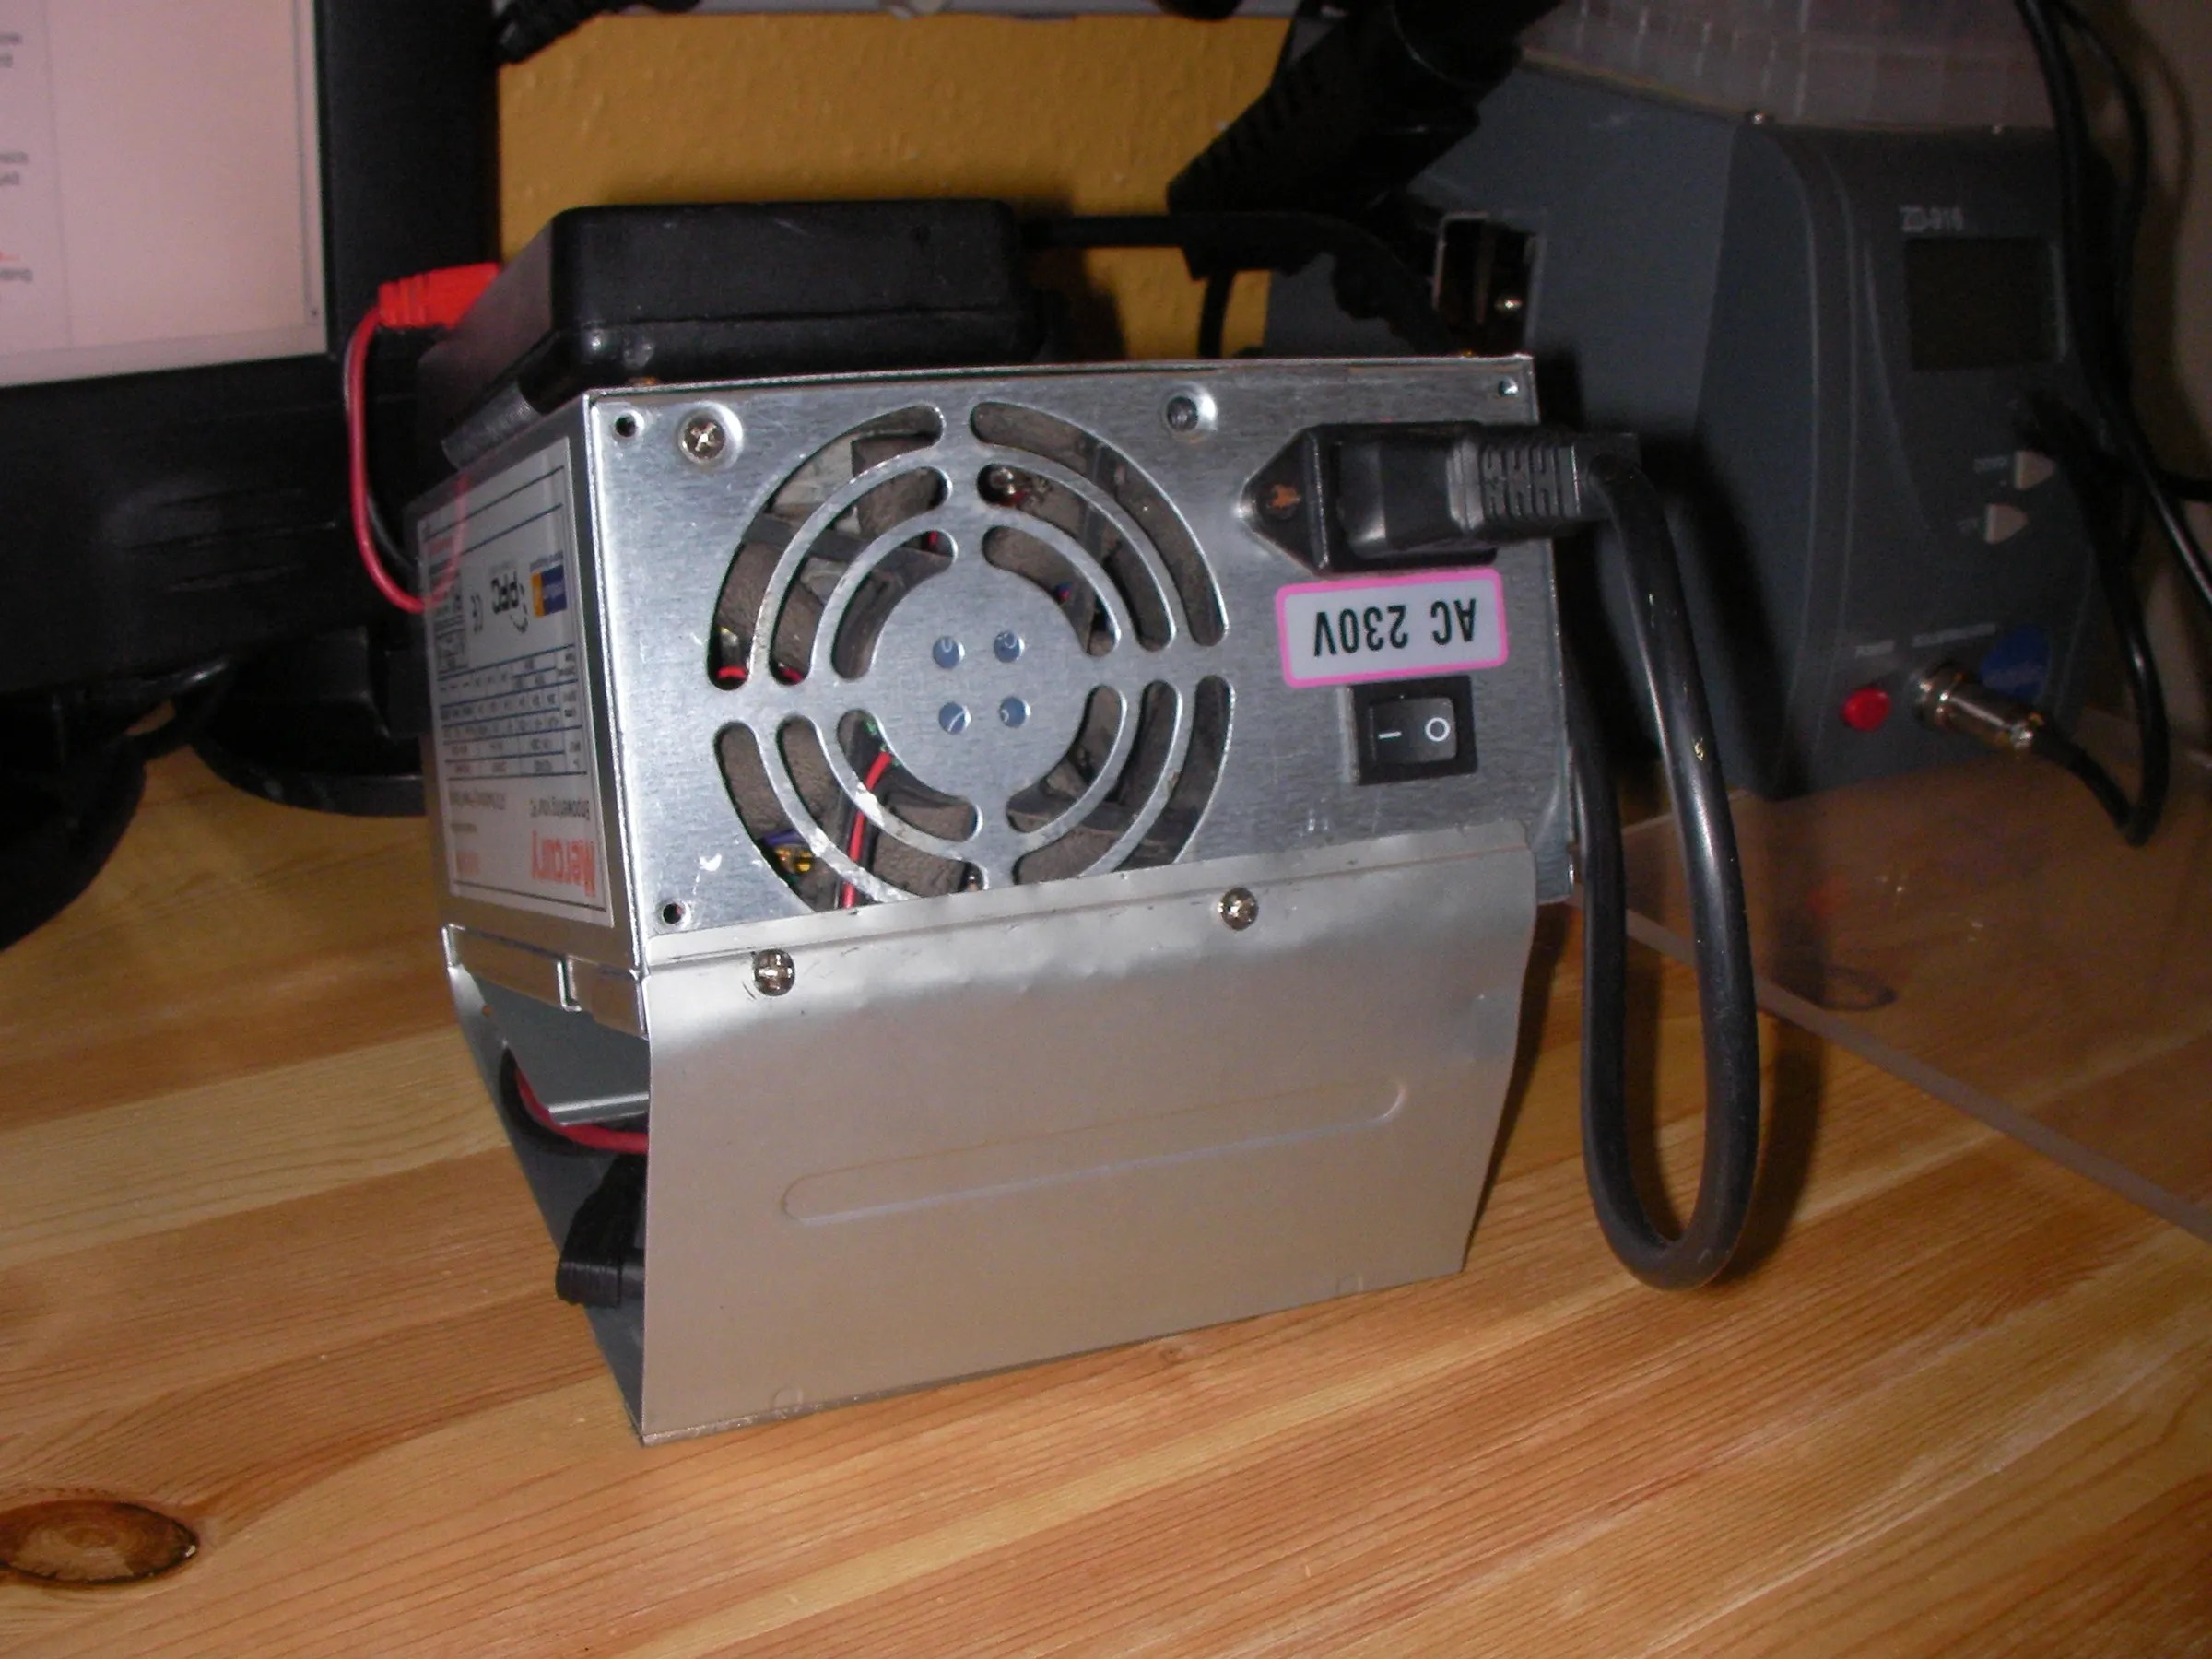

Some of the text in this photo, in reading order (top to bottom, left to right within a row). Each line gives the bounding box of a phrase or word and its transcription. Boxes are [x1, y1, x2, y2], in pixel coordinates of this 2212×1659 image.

[490, 570, 520, 614] PFC
[1313, 597, 1477, 658] AC 230V
[531, 829, 596, 899] Mercury
